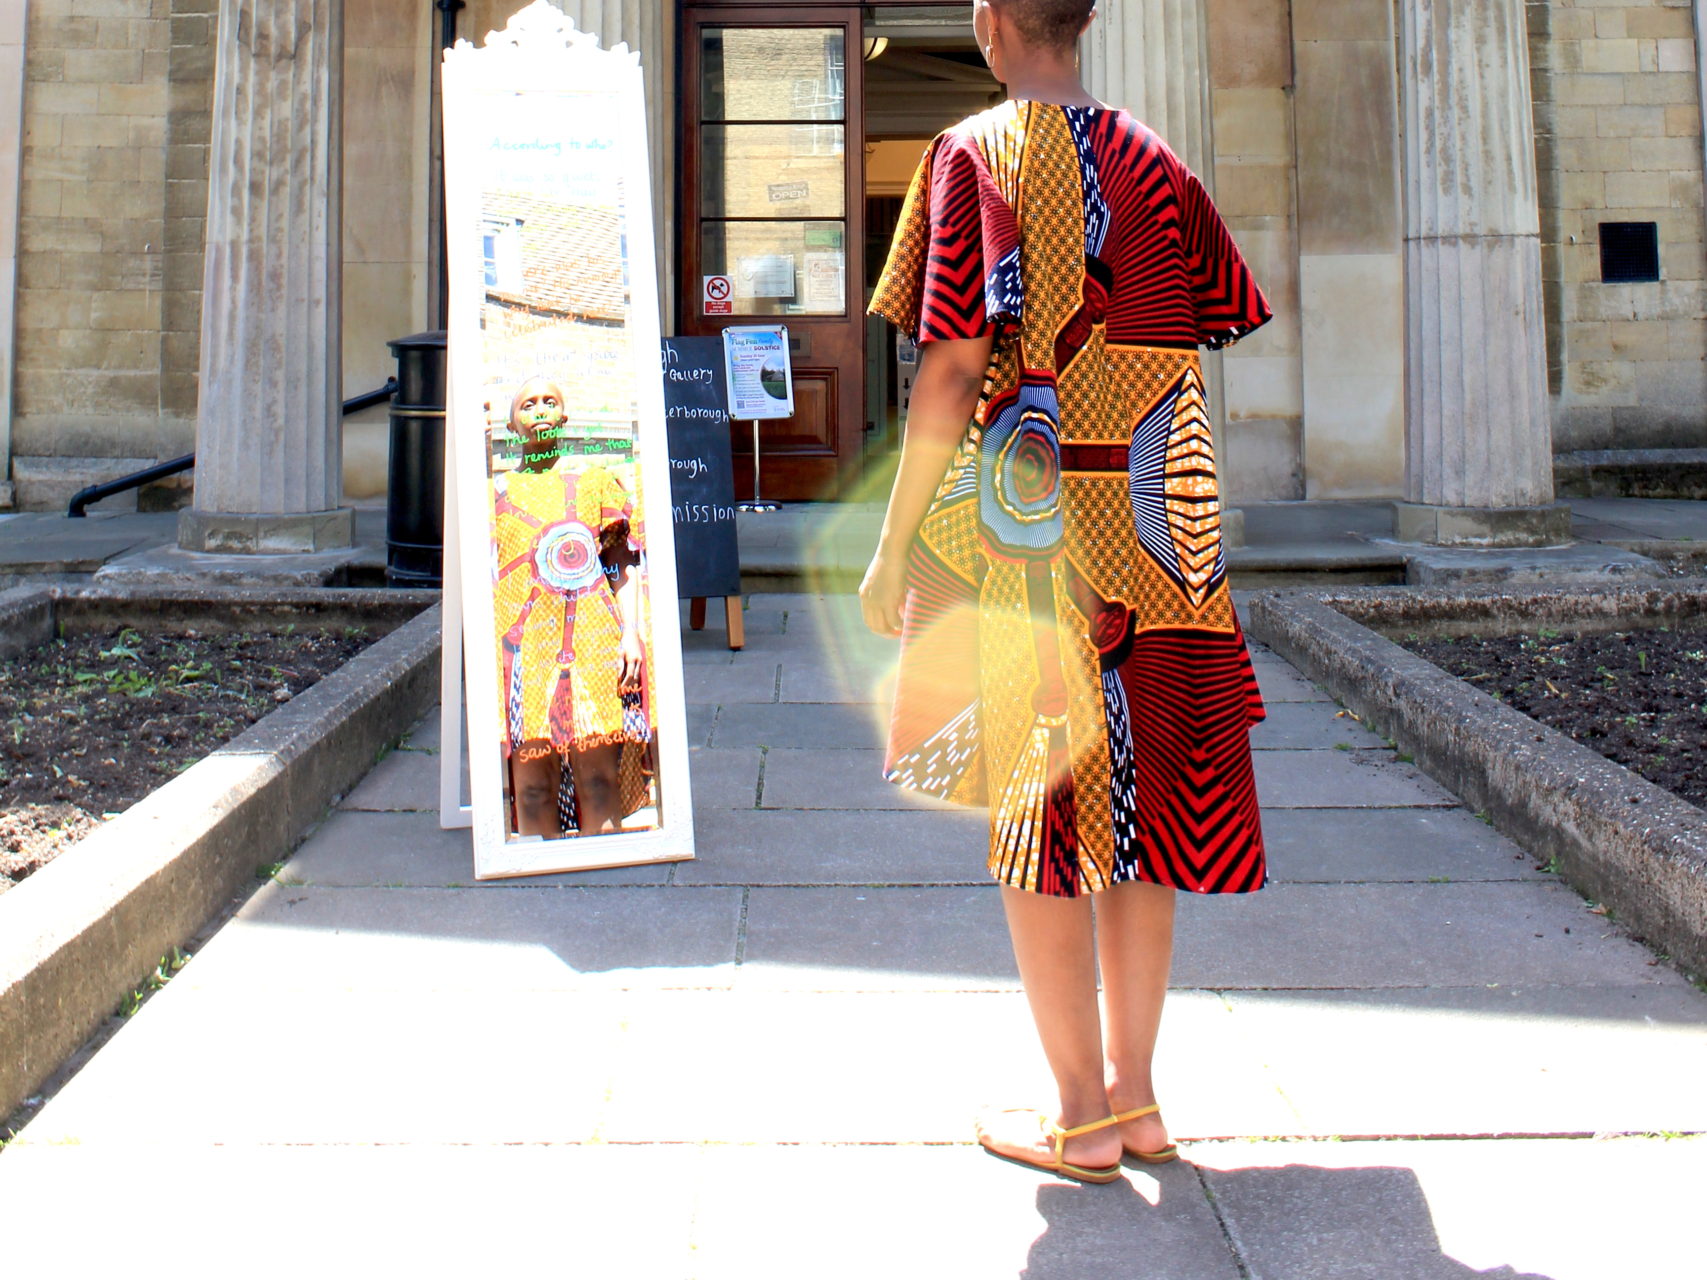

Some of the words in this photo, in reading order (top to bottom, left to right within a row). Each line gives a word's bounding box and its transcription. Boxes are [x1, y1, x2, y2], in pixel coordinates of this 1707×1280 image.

[772, 188, 806, 197] OPEN
[669, 368, 713, 384] Gallery
[584, 444, 603, 454] me
[519, 743, 552, 763] saw
[556, 739, 571, 763] of
